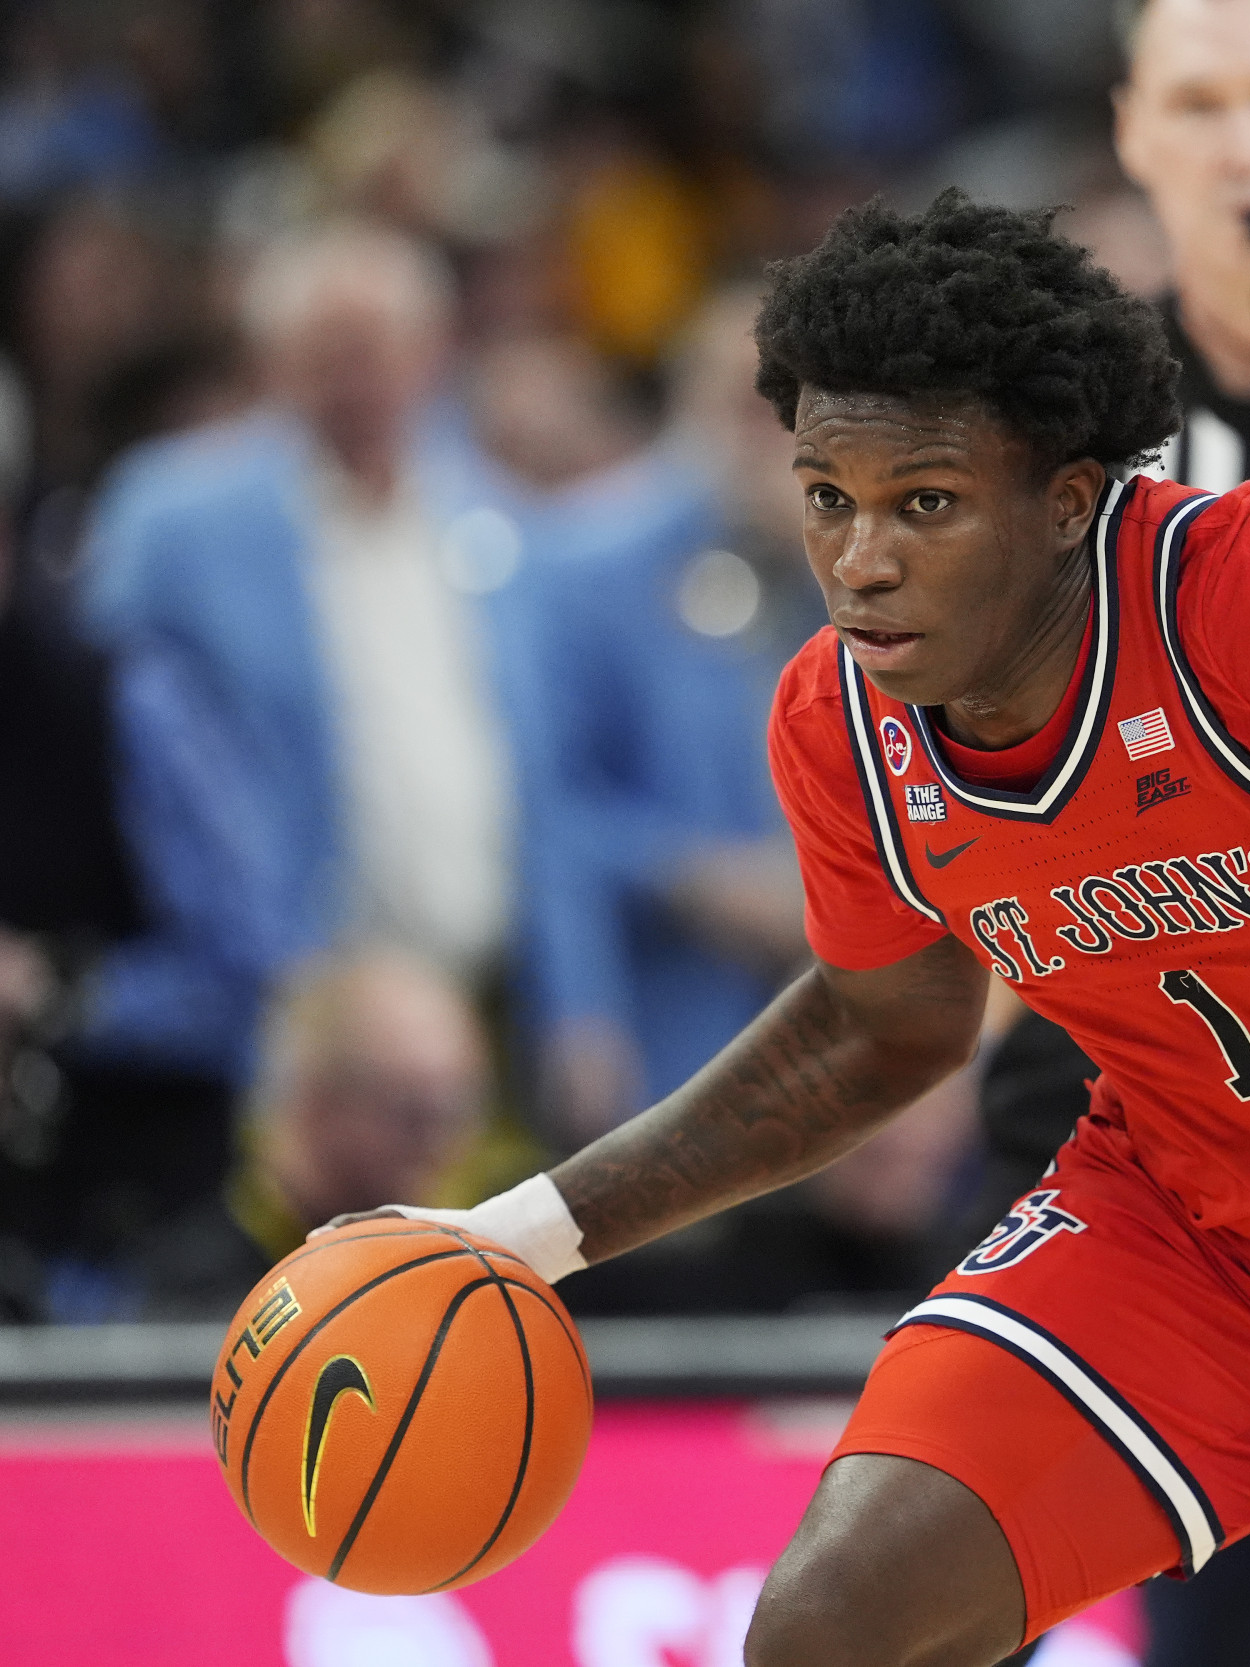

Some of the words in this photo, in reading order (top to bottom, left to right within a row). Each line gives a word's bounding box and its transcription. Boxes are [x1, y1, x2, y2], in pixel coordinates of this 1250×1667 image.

[914, 785, 940, 804] THE
[1136, 767, 1171, 794] BIG
[1136, 776, 1188, 808] EAST
[907, 802, 946, 821] HANGE
[970, 896, 1065, 983] ST.
[211, 1278, 303, 1468] ELITE
